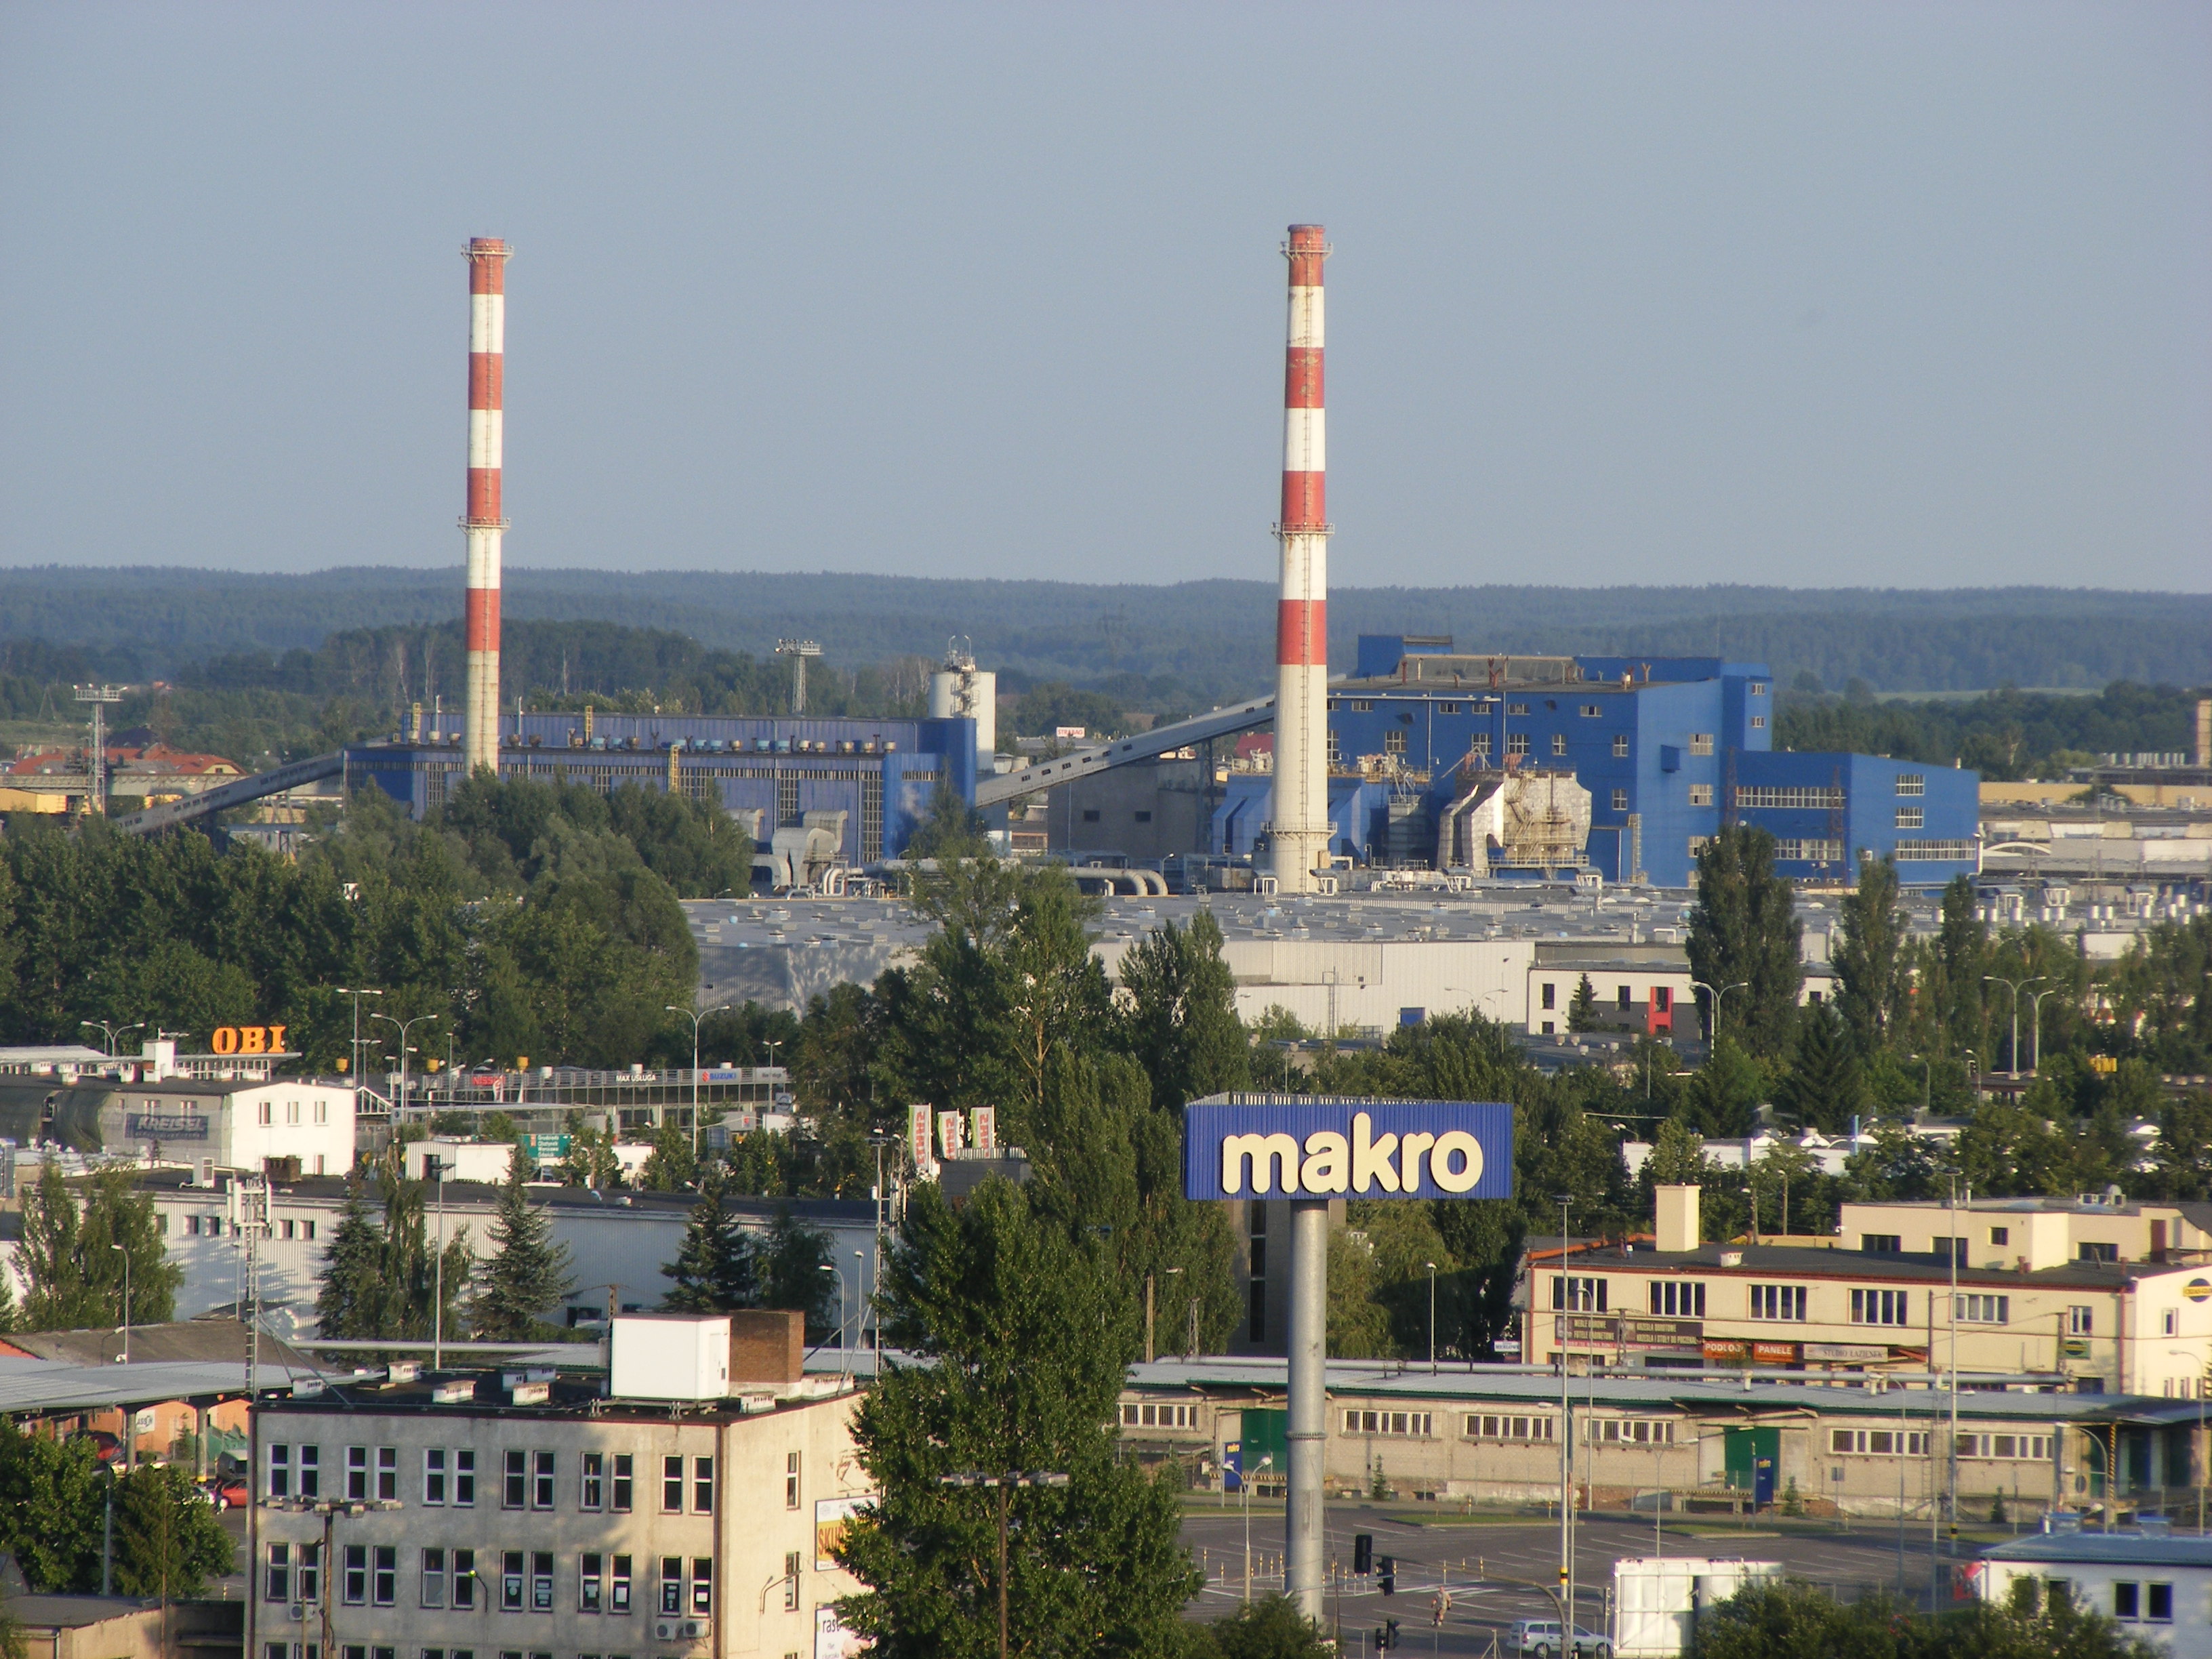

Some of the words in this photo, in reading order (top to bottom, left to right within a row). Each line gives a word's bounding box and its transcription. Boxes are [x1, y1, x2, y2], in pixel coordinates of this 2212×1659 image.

[212, 1026, 286, 1054] OBI
[137, 1115, 205, 1131] KREISEL
[1223, 1112, 1483, 1193] makro
[1759, 1345, 1793, 1354] PANELE
